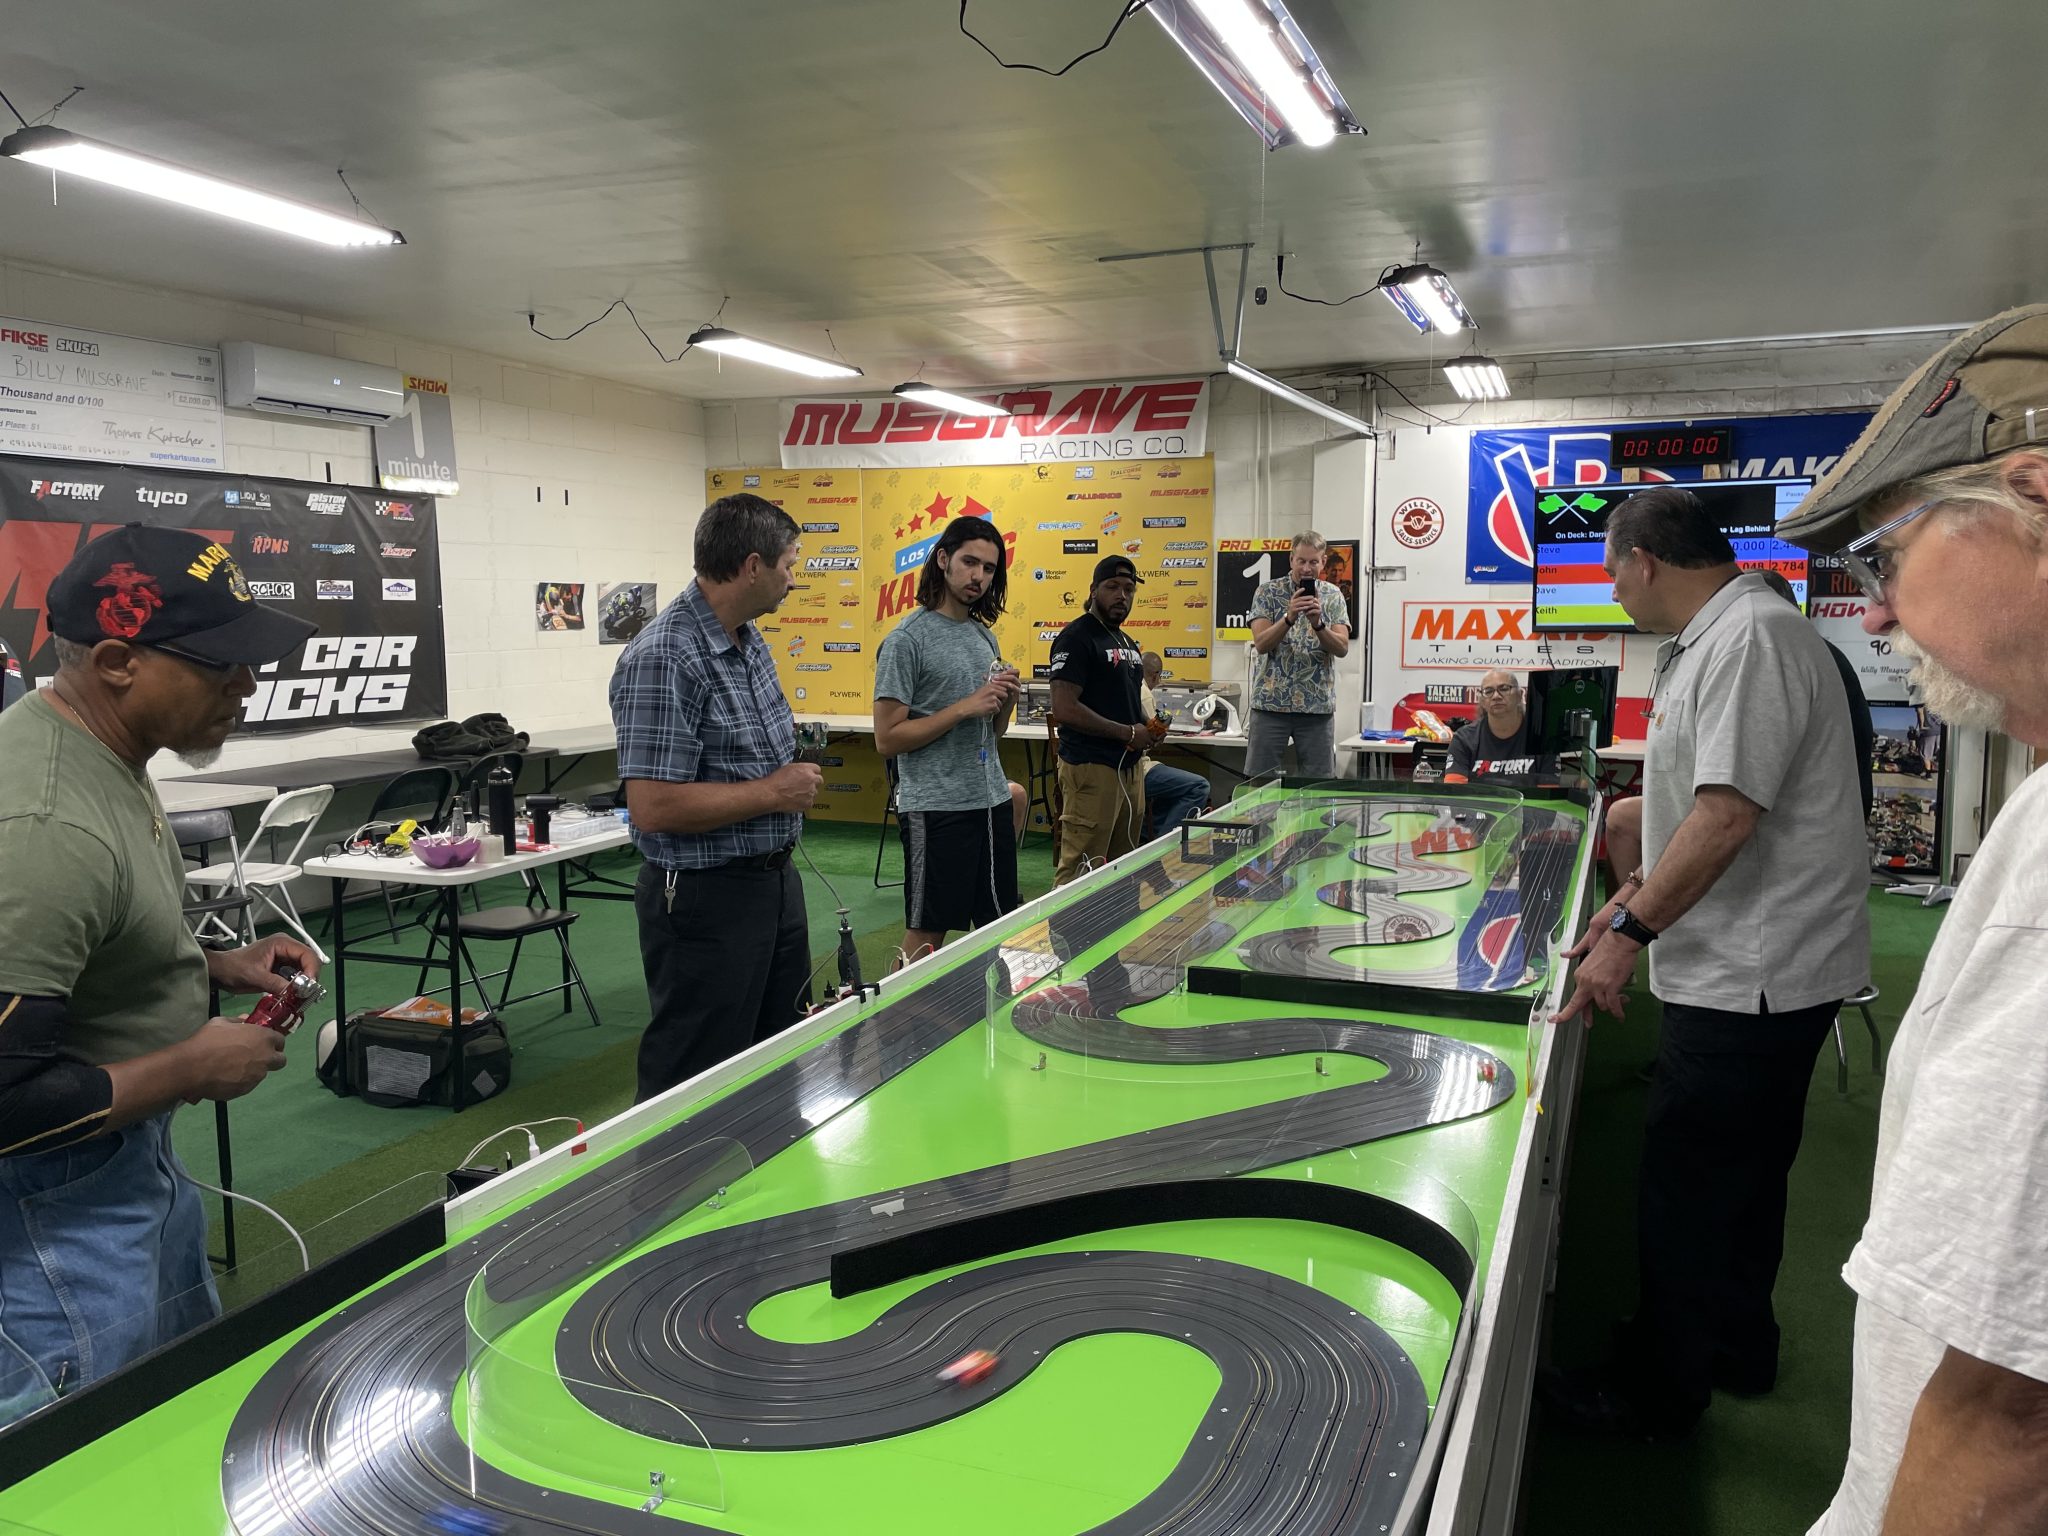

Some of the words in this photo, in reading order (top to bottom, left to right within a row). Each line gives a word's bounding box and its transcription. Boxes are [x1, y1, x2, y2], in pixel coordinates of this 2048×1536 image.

[1, 328, 48, 347] FIKSE
[56, 338, 99, 356] SKUSA
[12, 355, 64, 382] BILLY
[76, 366, 148, 391] MUSGRAVE
[409, 377, 447, 394] SHOW
[0, 386, 53, 401] Thousand
[55, 394, 75, 405] and
[77, 396, 104, 408] 0/100
[783, 381, 1204, 446] MUSGRAVE
[397, 393, 425, 459] 1
[1020, 439, 1132, 460] RACING
[1143, 436, 1188, 455] CO.
[388, 457, 450, 480] minute
[31, 480, 104, 498] FACTORY
[1150, 488, 1209, 497] MUSGRAVE
[136, 487, 188, 507] tyco
[383, 502, 413, 517] AFX
[1399, 501, 1437, 516] WILLYS
[1568, 531, 1588, 539] Deck:
[1730, 526, 1743, 534] Lag
[1745, 525, 1770, 533] Behind
[1220, 540, 1252, 551] PRO
[1261, 540, 1292, 550] SHO
[1732, 541, 1765, 551] 0.000
[806, 557, 861, 570] NASH
[900, 547, 924, 567] LOS
[1162, 558, 1208, 568] NASH
[1772, 561, 1804, 571] 2.784
[250, 583, 292, 597] SCHOR
[1121, 619, 1171, 627] USGRAVE
[300, 635, 418, 671] CAR
[1429, 644, 1594, 654] TIRES
[1418, 657, 1468, 665] MAKING
[1473, 657, 1523, 666] QUALITY
[1527, 658, 1536, 666] A
[1541, 658, 1606, 667] TRADITION
[241, 674, 411, 722] ACKS
[830, 690, 861, 698] PLYWERK
[1427, 686, 1464, 697] TALENT
[1472, 759, 1535, 775] FACTORY
